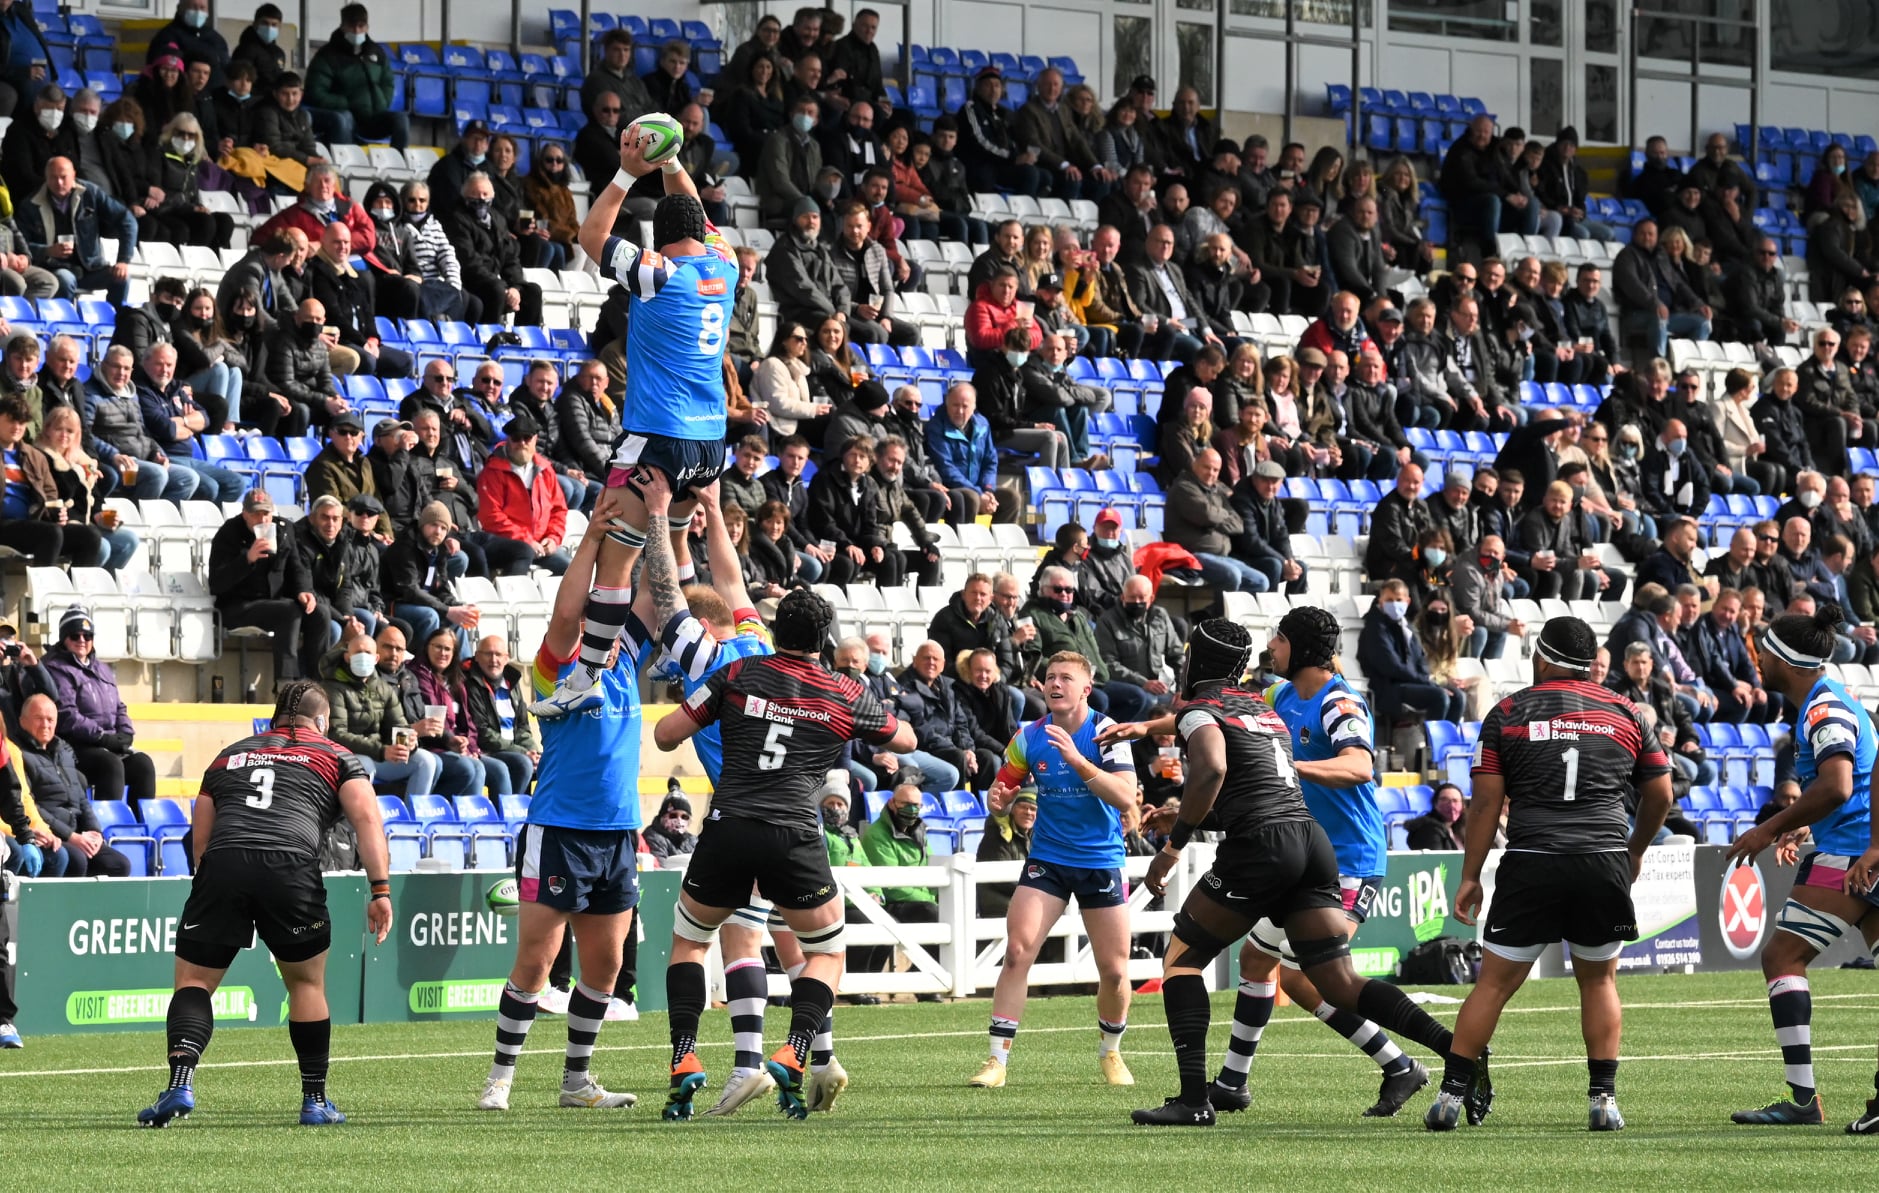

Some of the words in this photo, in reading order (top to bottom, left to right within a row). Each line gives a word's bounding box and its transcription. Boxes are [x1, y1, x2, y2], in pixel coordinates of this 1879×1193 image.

[698, 303, 724, 355] 8
[765, 711, 795, 725] Bank
[767, 701, 831, 722] Shawbrook
[1551, 719, 1616, 736] Shawbrook
[1551, 731, 1580, 741] Bank
[758, 722, 794, 770] 5
[1272, 737, 1296, 788] 4
[1561, 747, 1579, 800] 1
[245, 768, 276, 809] 3
[1657, 850, 1675, 866] Corp
[1678, 849, 1690, 863] Ltd
[1652, 869, 1664, 880] Tax
[1666, 870, 1692, 884] experts
[1408, 866, 1449, 928] IPA
[69, 917, 177, 955] GREENE
[410, 911, 508, 946] GREENE
[1655, 938, 1675, 949] Contact
[1684, 937, 1699, 950] today
[75, 997, 105, 1019] VISIT
[417, 986, 444, 1008] VISIT
